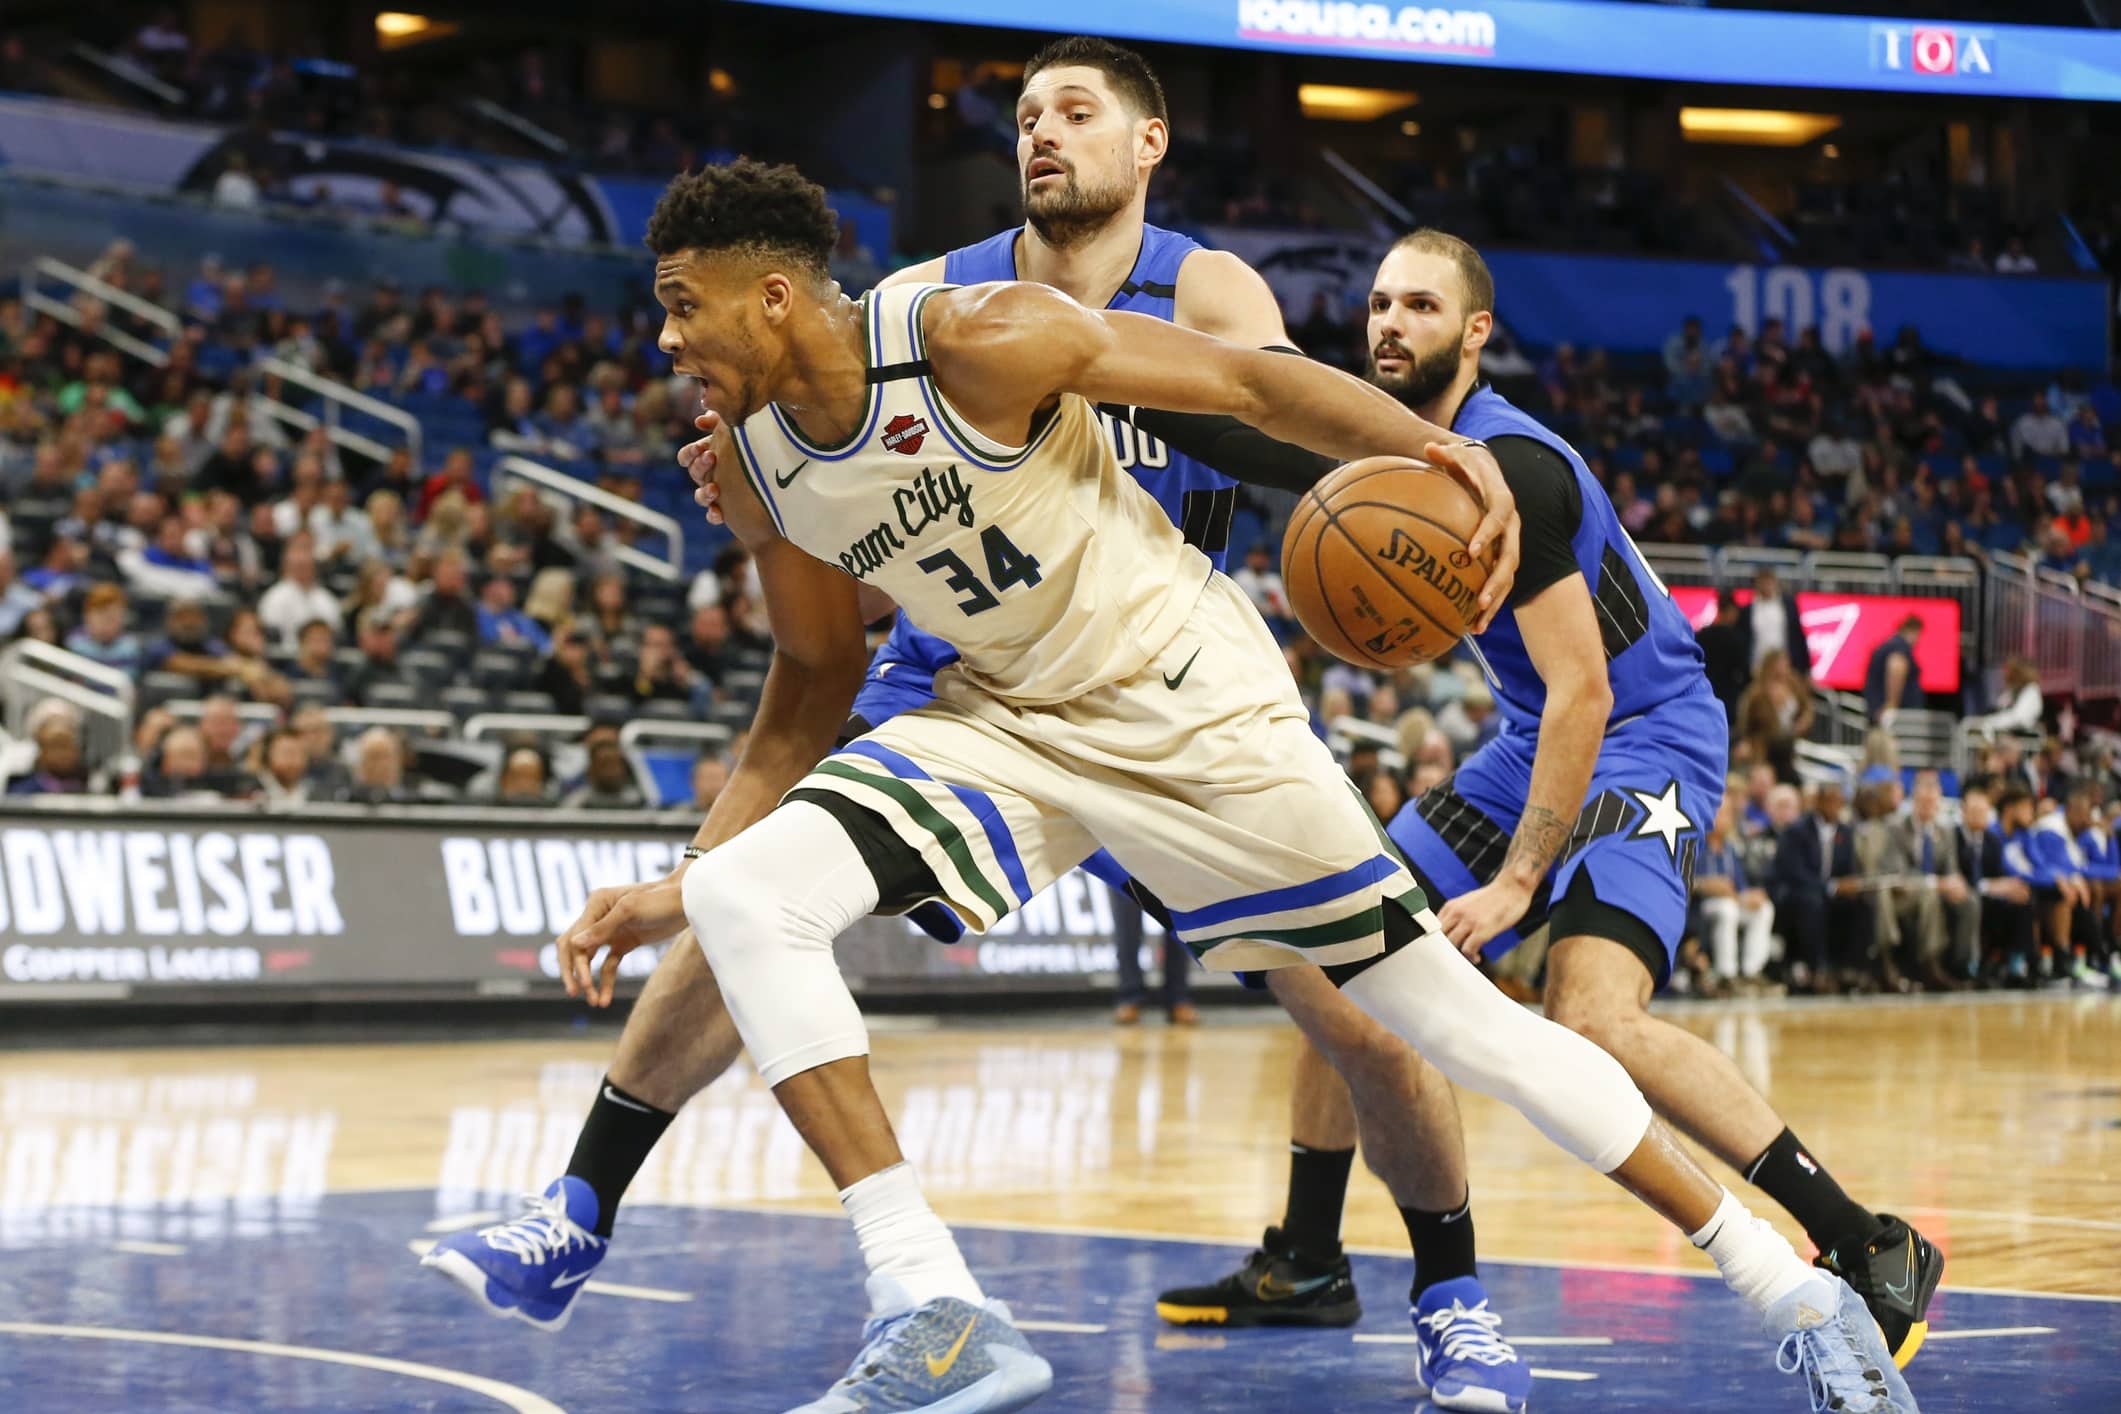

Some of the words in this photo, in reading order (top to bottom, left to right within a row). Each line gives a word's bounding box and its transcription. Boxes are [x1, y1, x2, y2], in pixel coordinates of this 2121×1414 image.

[1884, 28, 1993, 74] IOA
[1725, 264, 1873, 354] 108
[826, 521, 905, 579] eam
[892, 464, 975, 537] City
[916, 524, 1043, 617] 34
[1377, 528, 1478, 626] SPALDIN
